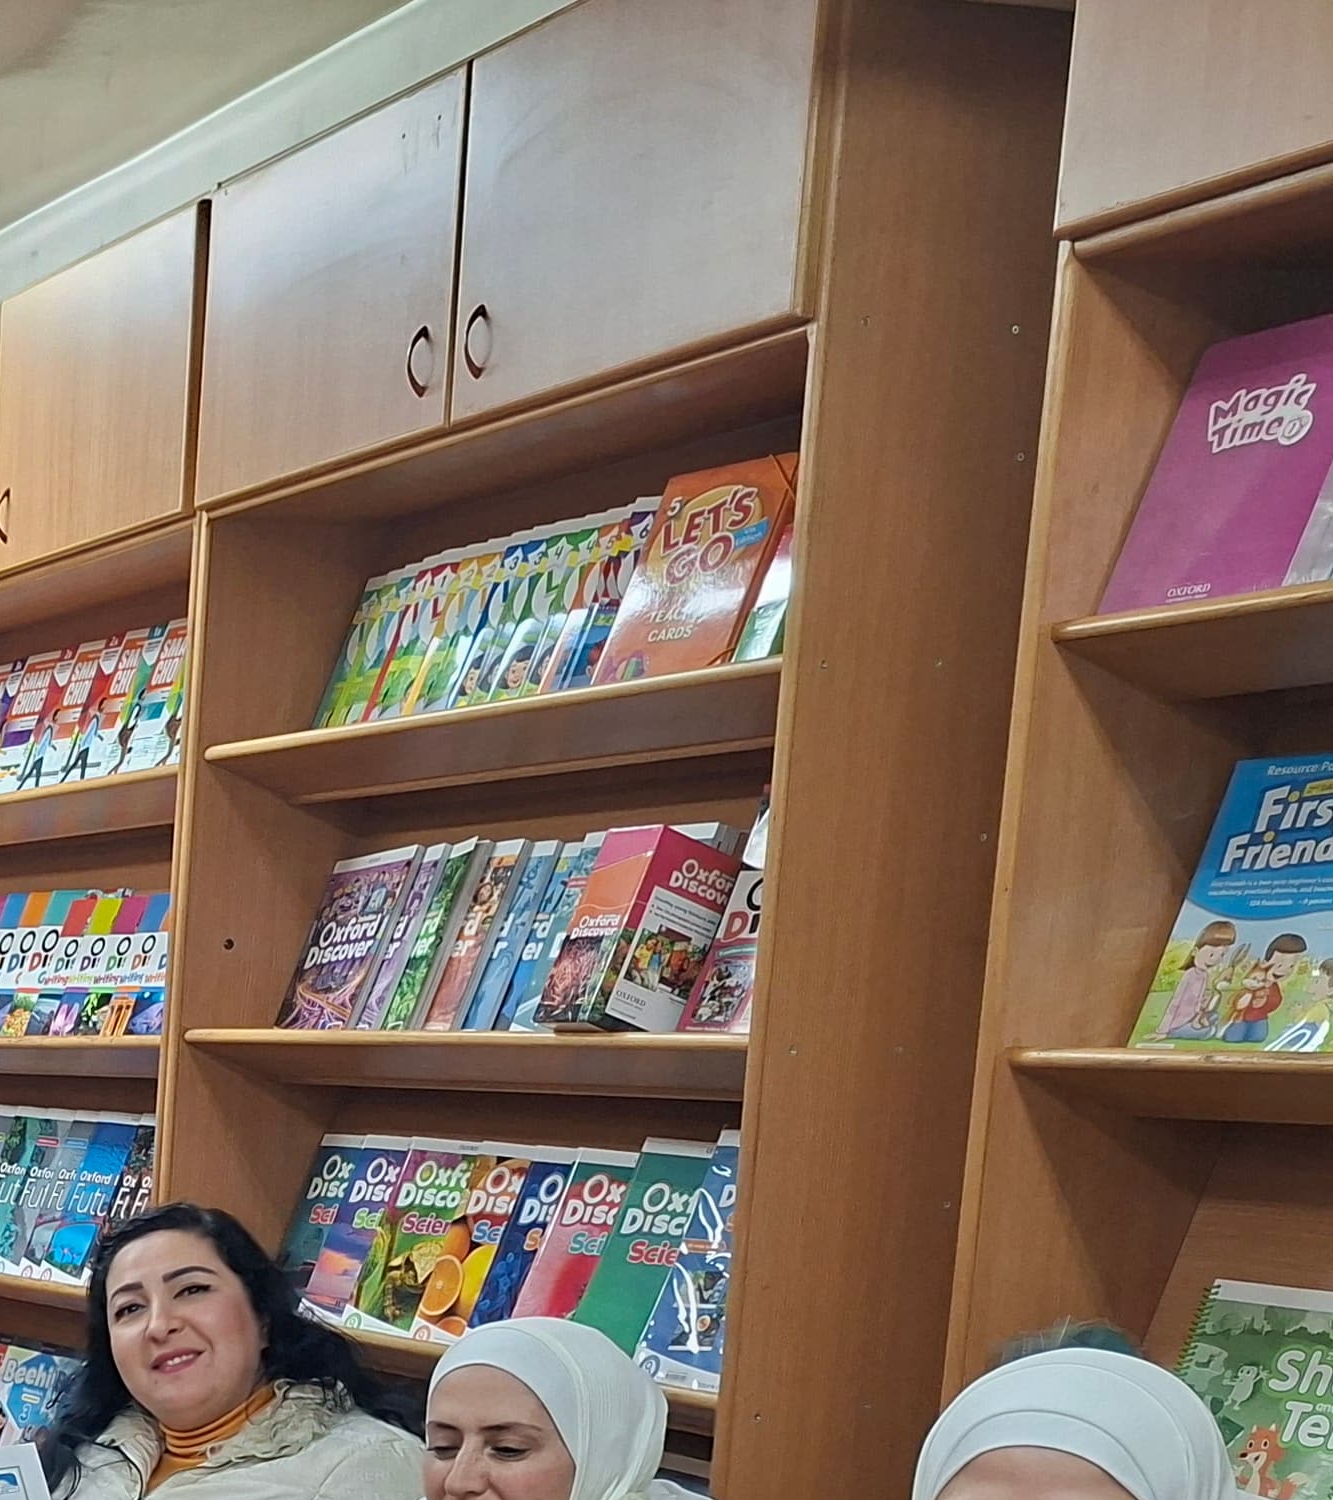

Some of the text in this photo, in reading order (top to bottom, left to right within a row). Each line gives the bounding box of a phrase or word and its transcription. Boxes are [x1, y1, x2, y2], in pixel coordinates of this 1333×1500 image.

[1211, 374, 1317, 428] Magic
[667, 496, 682, 516] 5
[639, 522, 650, 538] 6
[660, 487, 759, 556] LET'S
[663, 531, 733, 587] GO
[648, 624, 694, 642] CARDS
[23, 668, 51, 691] SMAR
[1267, 763, 1319, 776] Resource
[1254, 783, 1333, 834] Firs
[1220, 831, 1333, 874] Frien
[669, 870, 728, 905] Discov
[320, 915, 382, 949] Oxford
[570, 925, 619, 941] Discover
[578, 913, 621, 930] Oxford
[304, 940, 375, 969] Discover
[80, 1170, 111, 1186] Oxford
